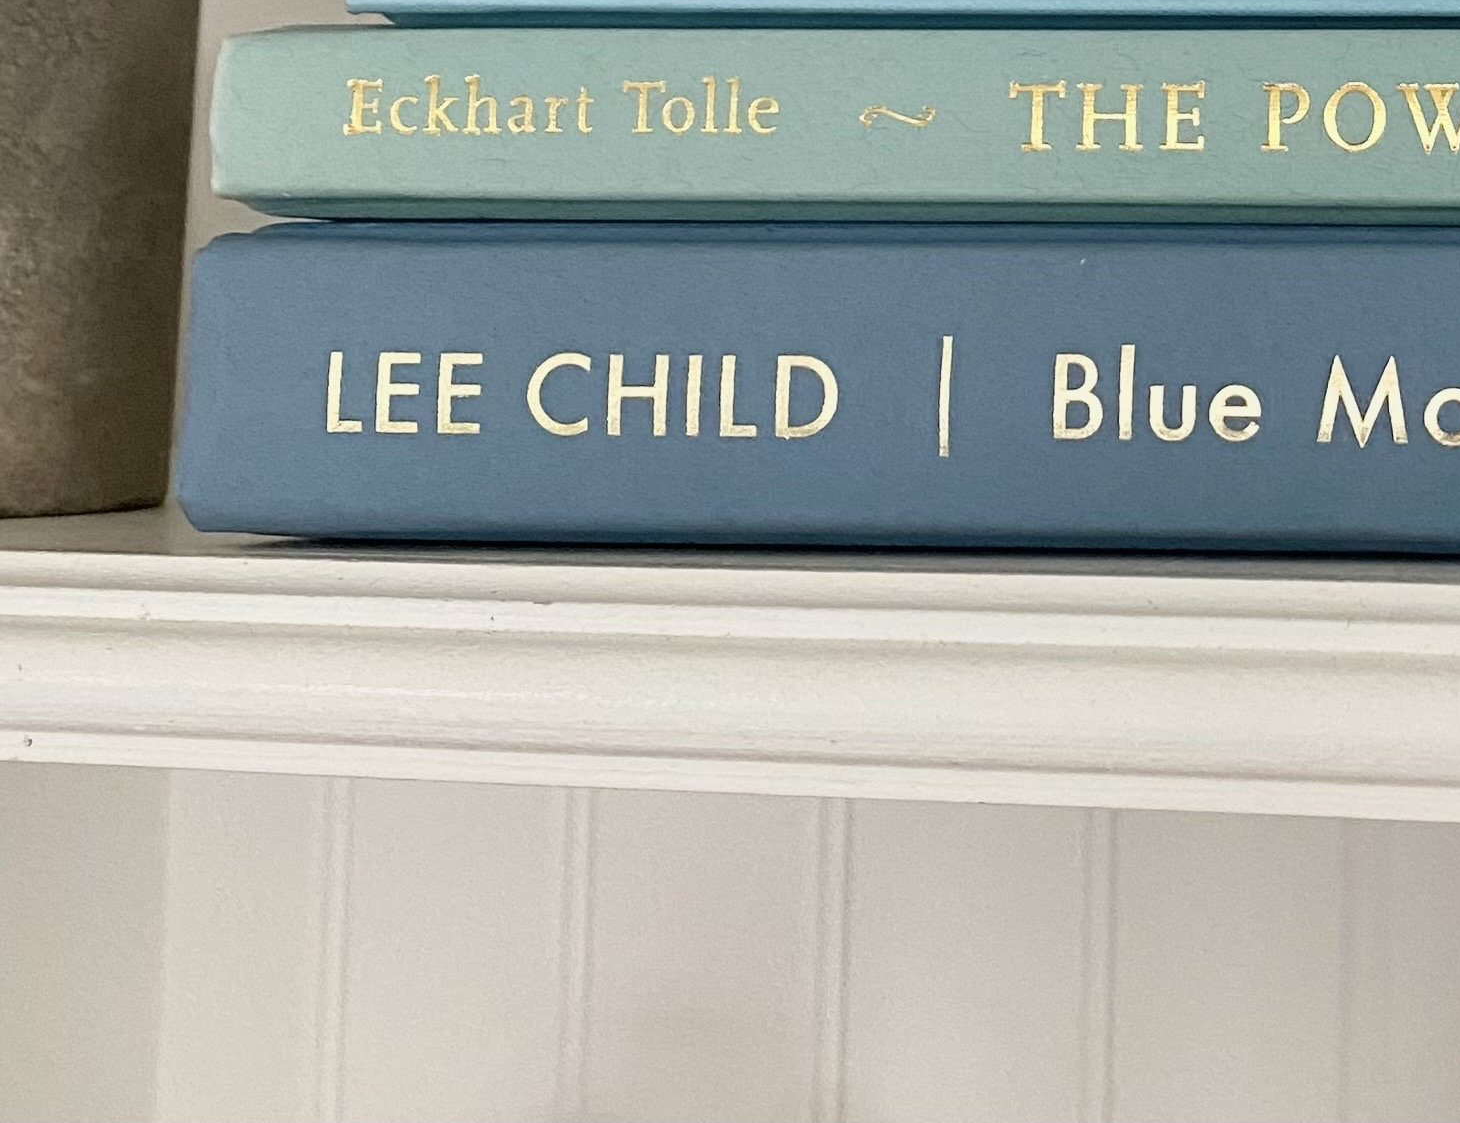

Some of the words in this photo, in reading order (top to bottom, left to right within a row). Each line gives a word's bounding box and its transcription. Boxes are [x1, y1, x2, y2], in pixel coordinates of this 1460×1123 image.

[341, 73, 595, 138] Eckhart
[621, 74, 780, 138] Tolle
[1008, 78, 1207, 154] THE
[325, 350, 485, 437] LEE
[526, 351, 840, 442] CHILD
[1052, 343, 1263, 443] Blue
